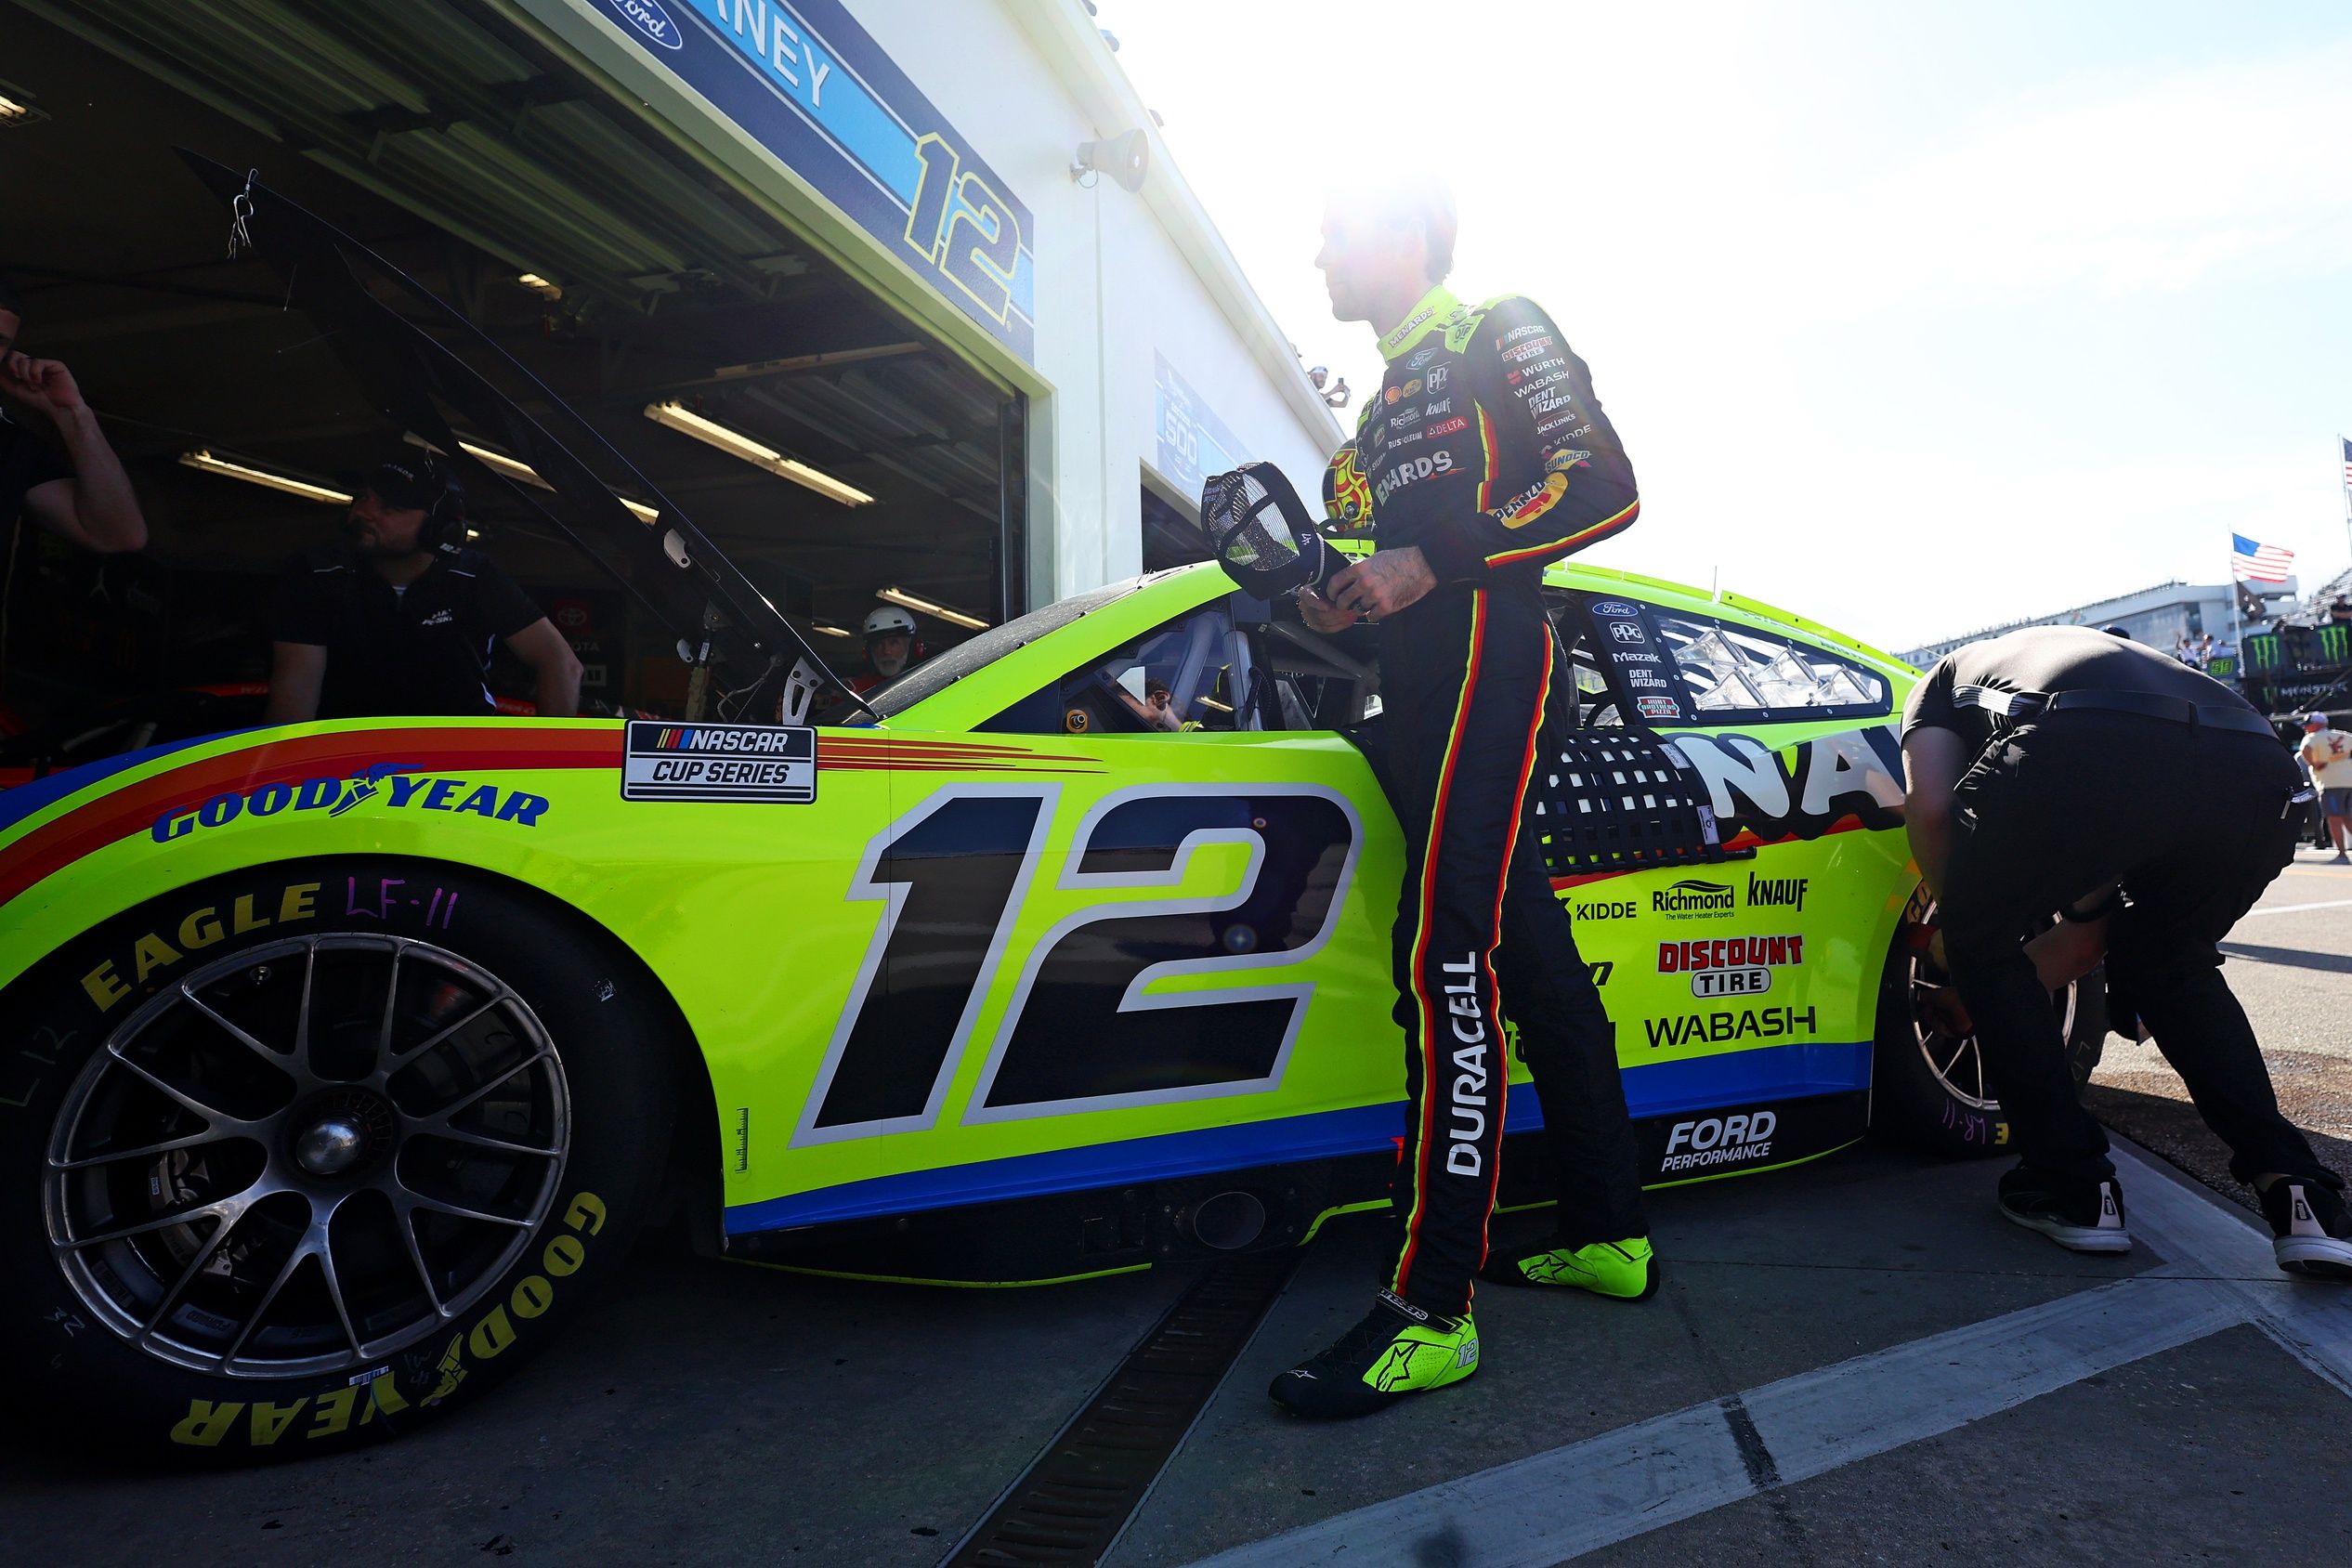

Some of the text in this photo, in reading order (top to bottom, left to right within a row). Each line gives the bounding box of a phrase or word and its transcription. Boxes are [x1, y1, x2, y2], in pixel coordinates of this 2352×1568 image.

[904, 132, 1021, 326] 12
[1389, 307, 1434, 347] MENARDS
[1508, 325, 1546, 342] NASCAR
[1514, 371, 1570, 399] WABASH
[1528, 386, 1556, 409] DENT
[1531, 395, 1571, 420] WIZARD
[1164, 408, 1198, 464] 500
[1436, 419, 1465, 435] DELTA
[1536, 421, 1555, 435] JACK
[1546, 451, 1590, 474] SUNOCO
[1376, 451, 1454, 506] ENARDS
[1602, 603, 1630, 614] Ford
[1614, 624, 1642, 641] PPG
[1613, 652, 1662, 663] Mazak
[1628, 669, 1653, 679] DENT
[1630, 678, 1667, 688] WIZARD
[689, 729, 789, 752] NASCAR
[653, 761, 790, 784] CUP SERIES
[1653, 884, 1734, 911] Richmond
[1747, 871, 1809, 912] KNAUF
[1576, 902, 1637, 921] KIDDE
[1694, 911, 1713, 920] Heater
[1714, 910, 1734, 919] Experts
[80, 882, 321, 1013] EAGLE
[1657, 935, 1803, 973] DISCOUNT
[787, 781, 1365, 1150] 12
[1699, 972, 1762, 994] TIRE
[1644, 1006, 1817, 1048] WABASH
[1443, 951, 1486, 1177] DURACELL
[1666, 1110, 1777, 1155] FORD
[1661, 1142, 1771, 1172] PERFORMANCE
[1456, 1338, 1478, 1369] 12
